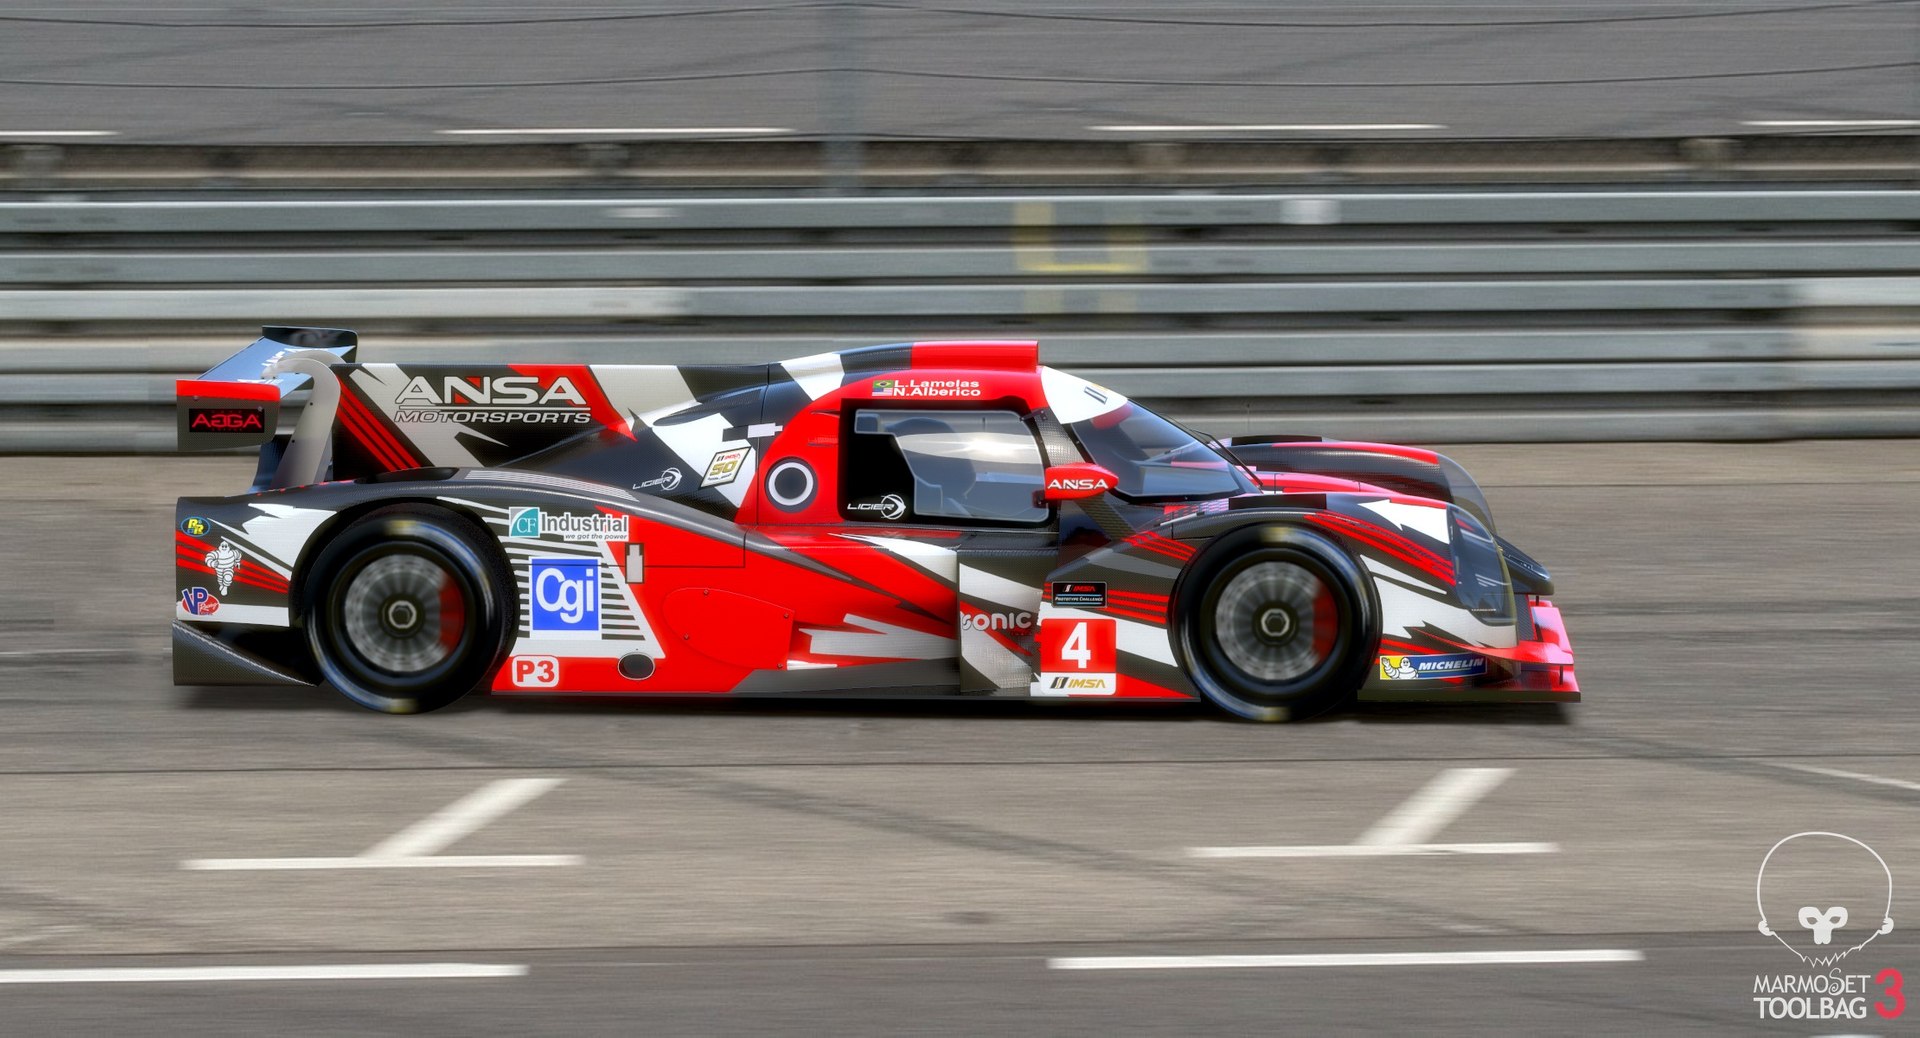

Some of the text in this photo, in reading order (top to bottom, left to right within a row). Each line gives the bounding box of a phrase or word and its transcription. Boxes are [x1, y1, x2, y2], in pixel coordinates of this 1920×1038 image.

[395, 376, 587, 405] ANSA
[894, 379, 980, 388] L.Lamelas
[893, 387, 981, 397] N.Alberico
[395, 410, 591, 424] MOTORSPORTS
[710, 460, 738, 476] 50
[632, 474, 673, 490] LIGIER
[1047, 479, 1109, 490] ANSA
[847, 502, 895, 512] LIGIER
[516, 513, 628, 533] CF Industrial
[577, 533, 590, 541] got
[604, 533, 628, 541] power
[182, 587, 208, 615] VP
[535, 568, 594, 624] Cgi
[1061, 621, 1091, 669] 4
[516, 660, 555, 683] P3
[1418, 657, 1484, 671] MICHELIN
[1067, 679, 1106, 689] IMSA
